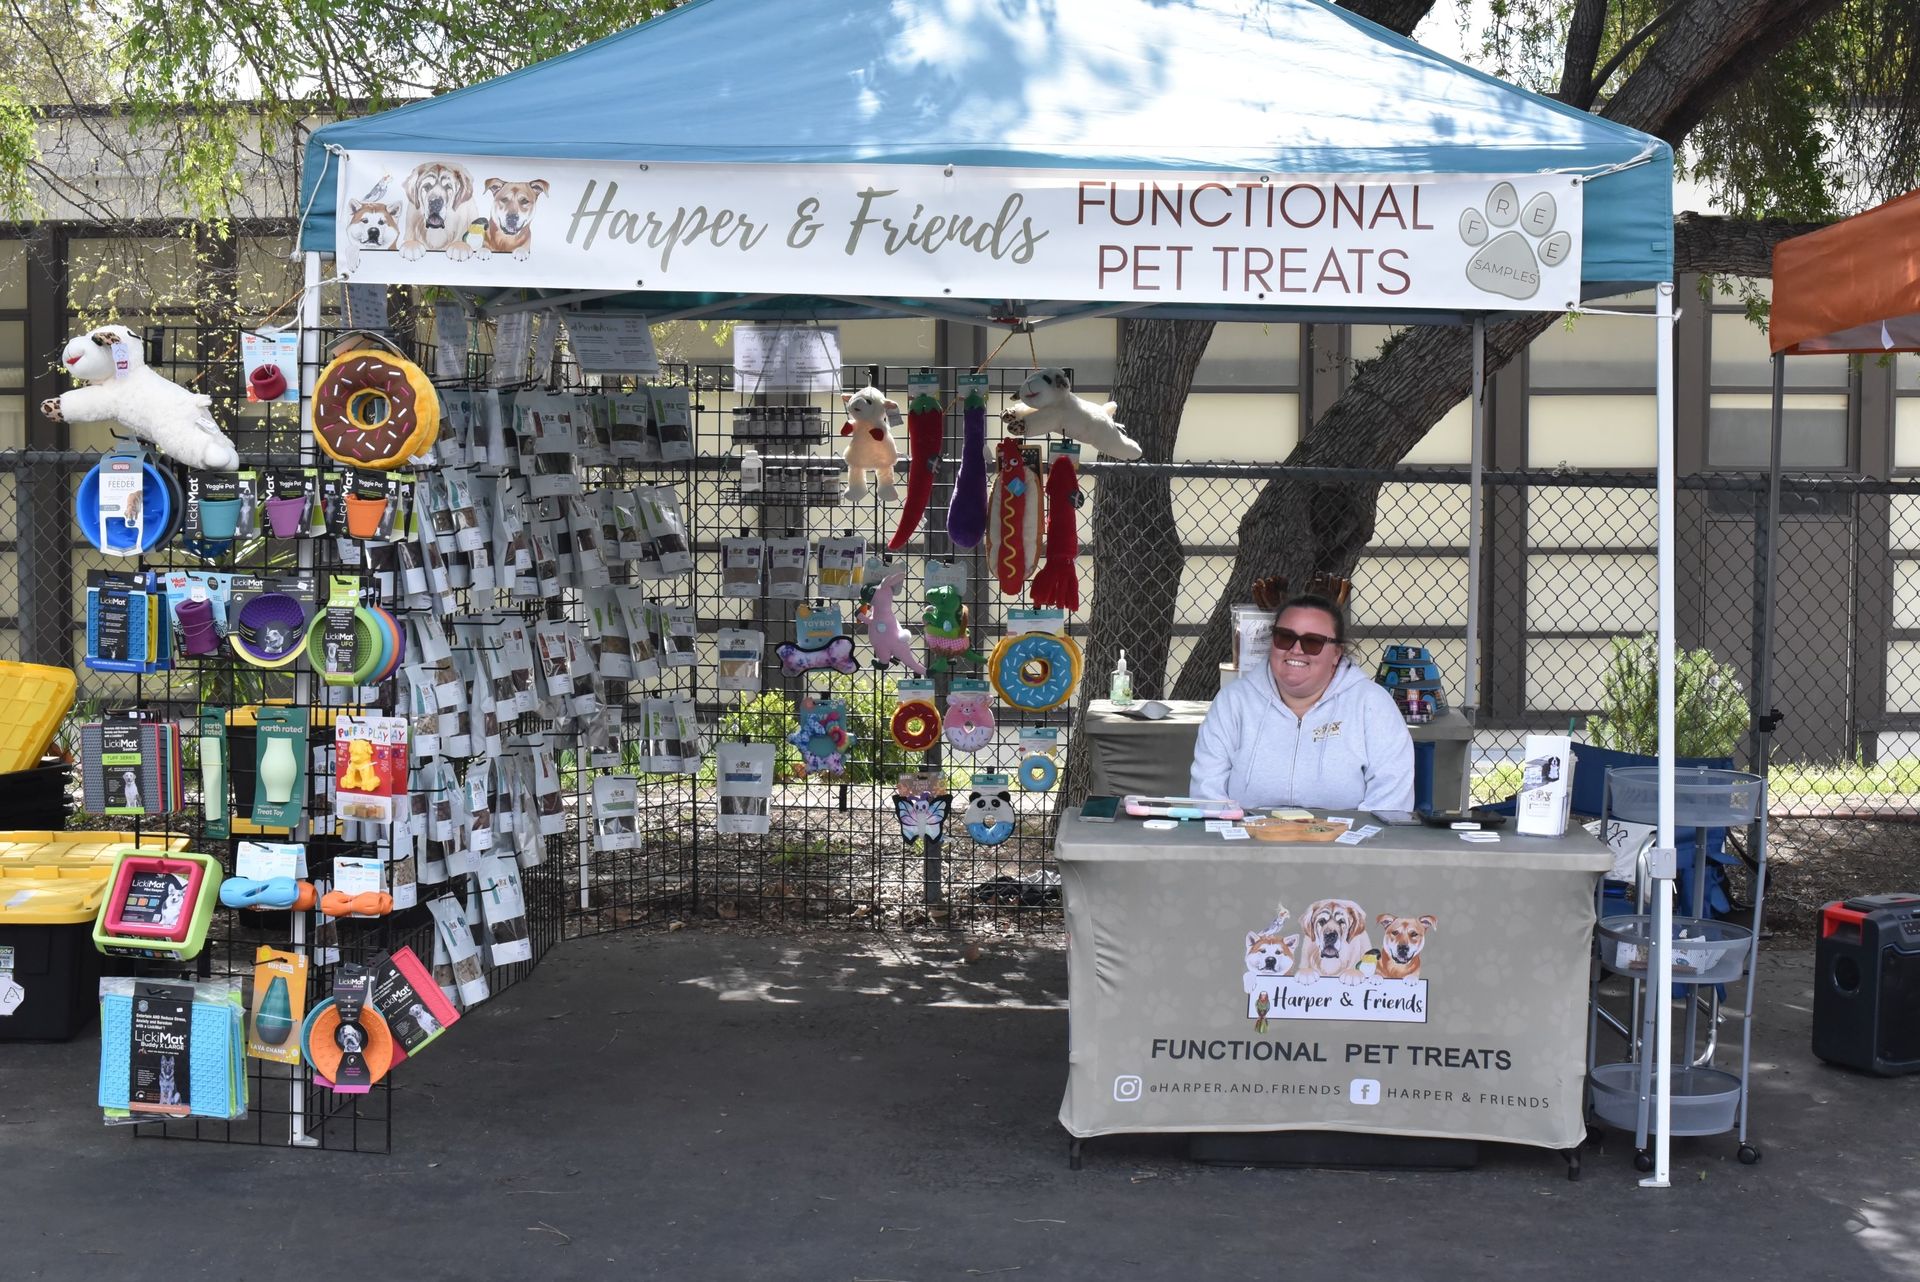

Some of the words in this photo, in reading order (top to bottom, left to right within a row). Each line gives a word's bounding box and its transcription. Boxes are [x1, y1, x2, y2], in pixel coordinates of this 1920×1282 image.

[1077, 180, 1433, 231] FUNCTIONAL
[565, 178, 769, 274] Harper
[786, 197, 825, 249] &
[845, 186, 1050, 263] Friends
[1099, 245, 1192, 291] PET
[1213, 247, 1411, 295] TREATS
[1473, 258, 1538, 285] SAMPLES
[108, 480, 135, 488] FEEDER
[205, 483, 224, 491] Yoggie
[358, 479, 374, 488] Yoggie
[187, 476, 199, 530] LickiMat
[100, 597, 126, 606] LickiMat
[325, 632, 354, 641] LickiMat
[260, 724, 281, 732] earth
[368, 727, 388, 742] PLAY
[104, 739, 138, 748] LickiMat
[131, 879, 165, 889] LickiMat
[381, 984, 411, 1012] ickiMat
[1272, 985, 1333, 1011] Harper
[1339, 991, 1354, 1008] &
[1363, 988, 1423, 1014] Friends
[135, 1030, 185, 1045] LickiMat
[1151, 1038, 1327, 1063] FUNCTIONAL
[1345, 1044, 1400, 1065] PET
[1407, 1046, 1512, 1071] TREATS
[1150, 1082, 1342, 1097] @HARPER.AND.FRIENDS
[1387, 1087, 1457, 1103] HARPER
[1461, 1093, 1473, 1104] &
[1479, 1093, 1550, 1109] FRIENDS
